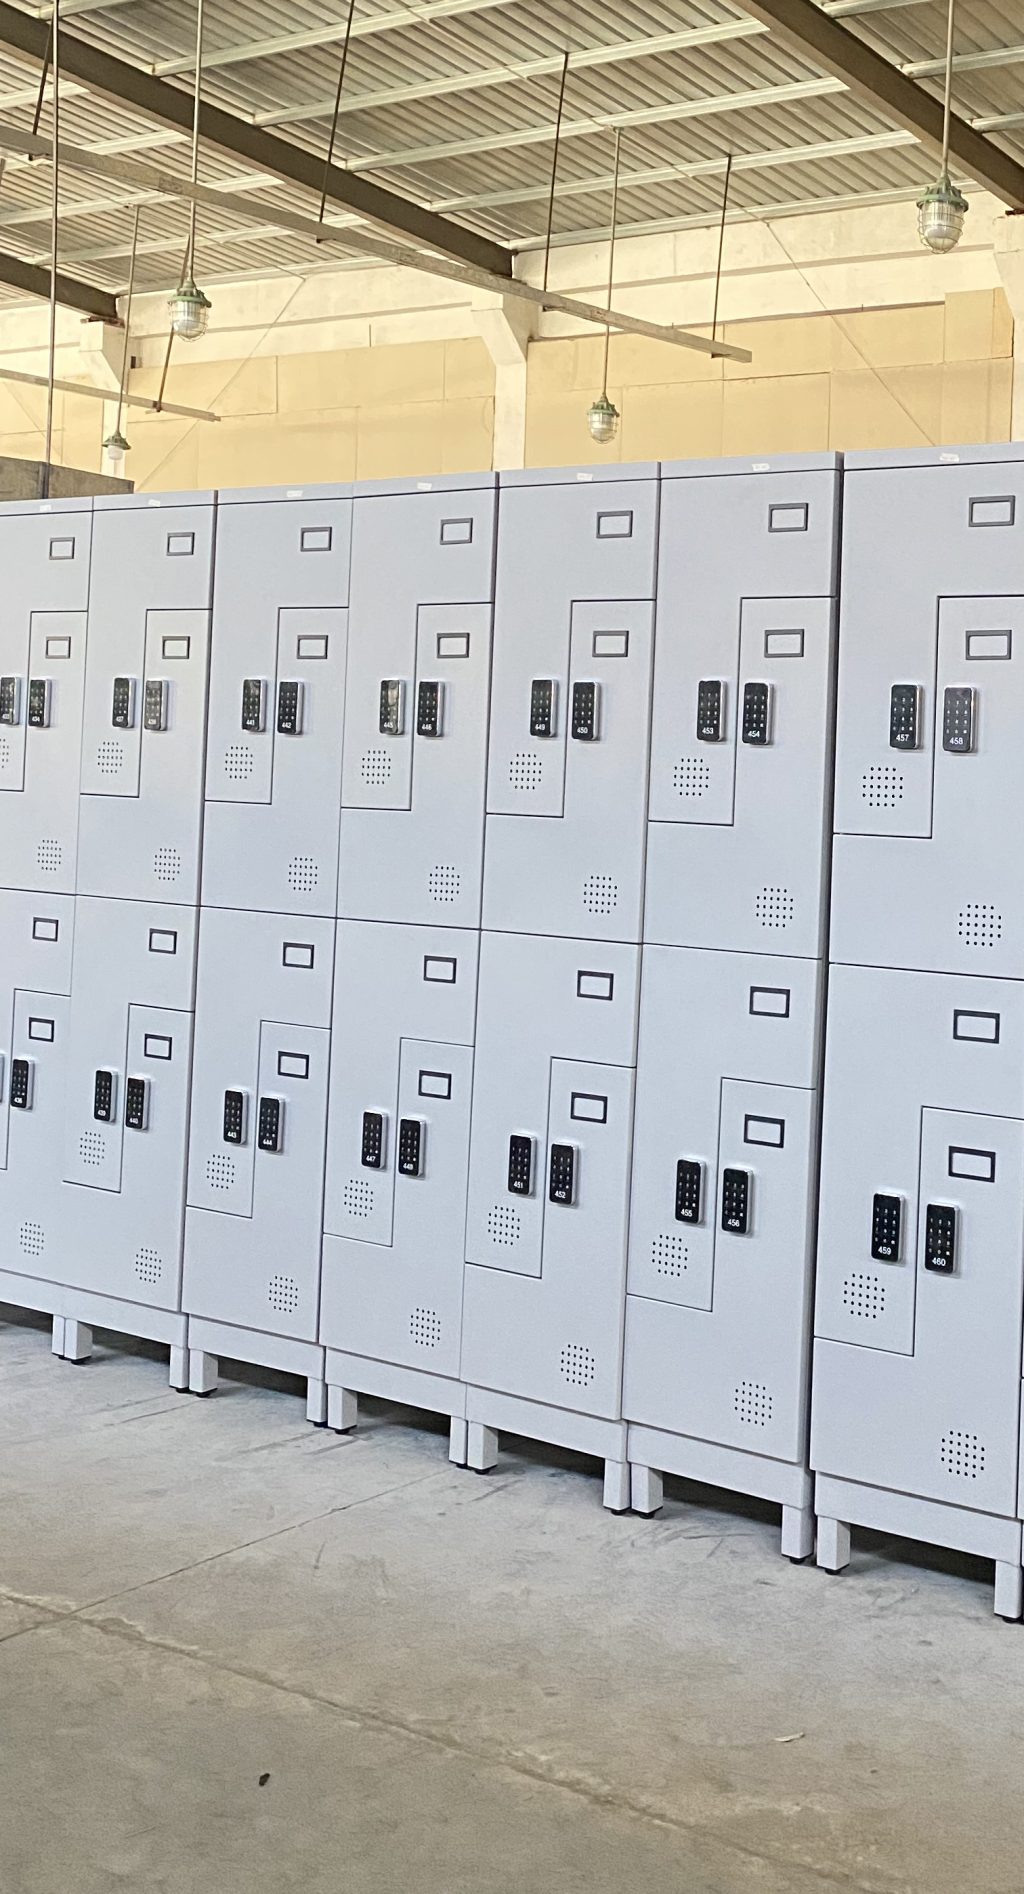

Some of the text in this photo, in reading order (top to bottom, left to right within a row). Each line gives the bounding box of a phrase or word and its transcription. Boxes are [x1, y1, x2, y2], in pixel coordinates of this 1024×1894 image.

[281, 721, 292, 729] 442
[534, 723, 546, 731] 449
[576, 726, 589, 734] 450
[701, 726, 714, 735] 453
[747, 730, 761, 738] 454
[895, 733, 910, 742] 457
[949, 736, 964, 745] 458
[513, 1180, 524, 1189] 451
[554, 1190, 566, 1199] 452
[680, 1208, 693, 1218] 455
[727, 1218, 740, 1228] 456
[877, 1245, 892, 1256] 459
[931, 1257, 947, 1267] 460
